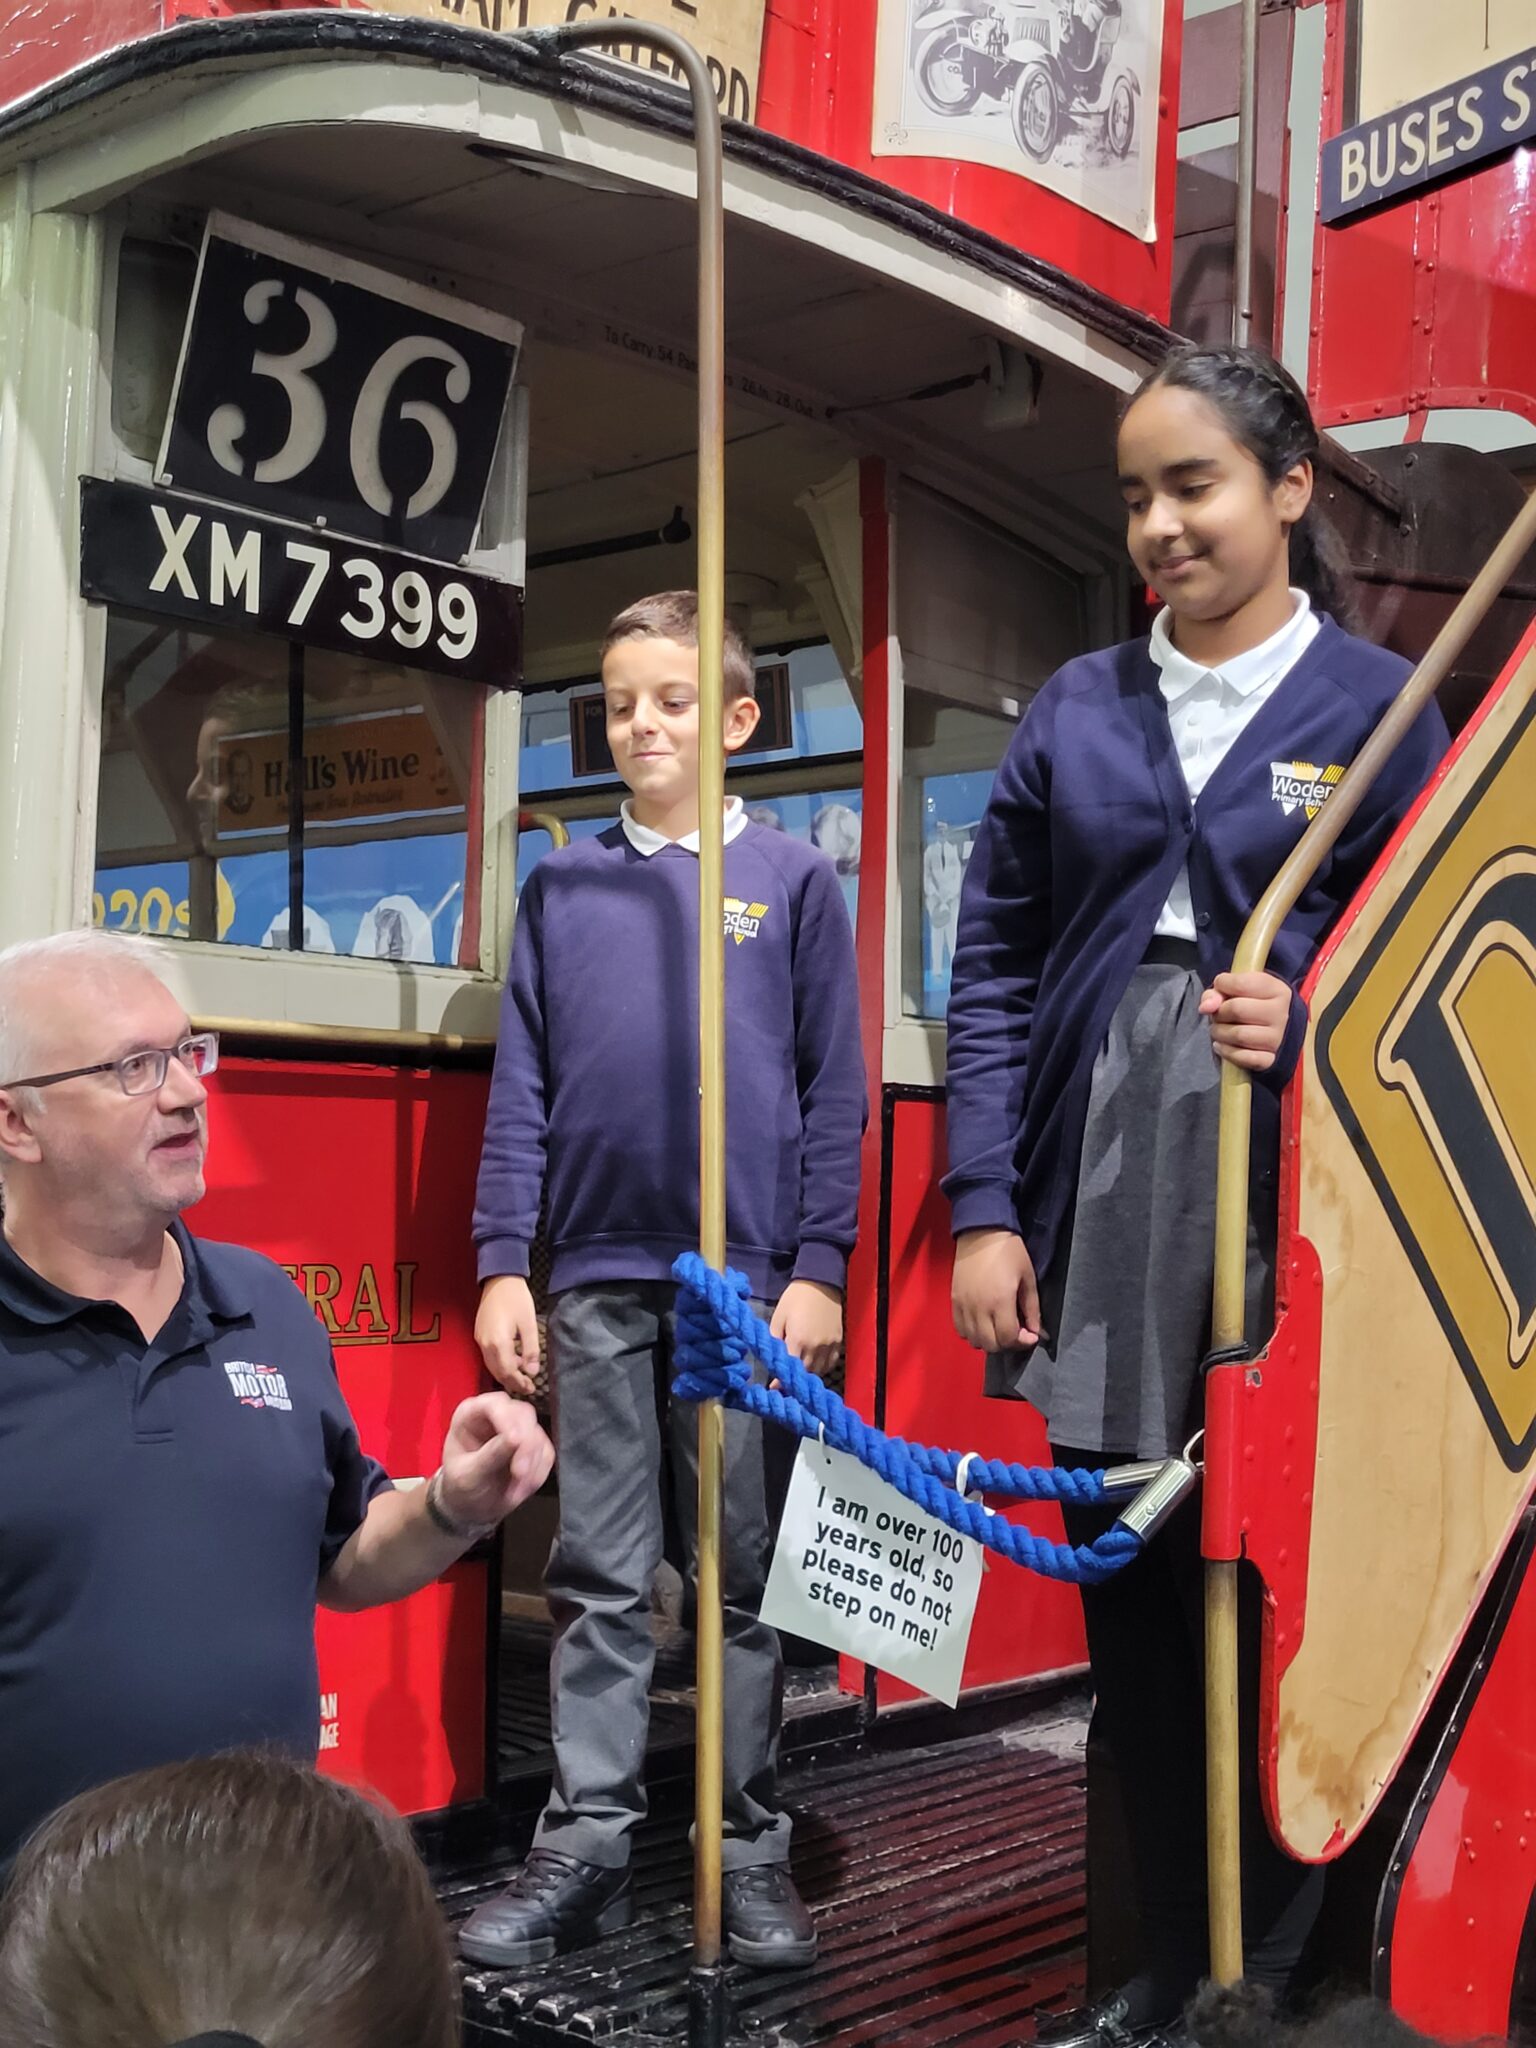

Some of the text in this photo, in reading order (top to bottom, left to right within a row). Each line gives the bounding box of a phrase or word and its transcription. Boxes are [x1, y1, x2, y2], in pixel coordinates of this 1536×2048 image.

[1341, 60, 1536, 203] BUSES S
[207, 279, 471, 520] 36
[149, 504, 478, 660] XM 7399
[264, 754, 336, 798] Hll's
[342, 748, 420, 787] Wine
[1271, 793, 1304, 807] Primary
[278, 1262, 441, 1345] RAL
[228, 1373, 289, 1398] MOTOR
[815, 1521, 953, 1592] years old, so
[817, 1486, 963, 1563] I am over 100
[802, 1548, 952, 1626] please do not
[808, 1581, 938, 1651] step on me!
